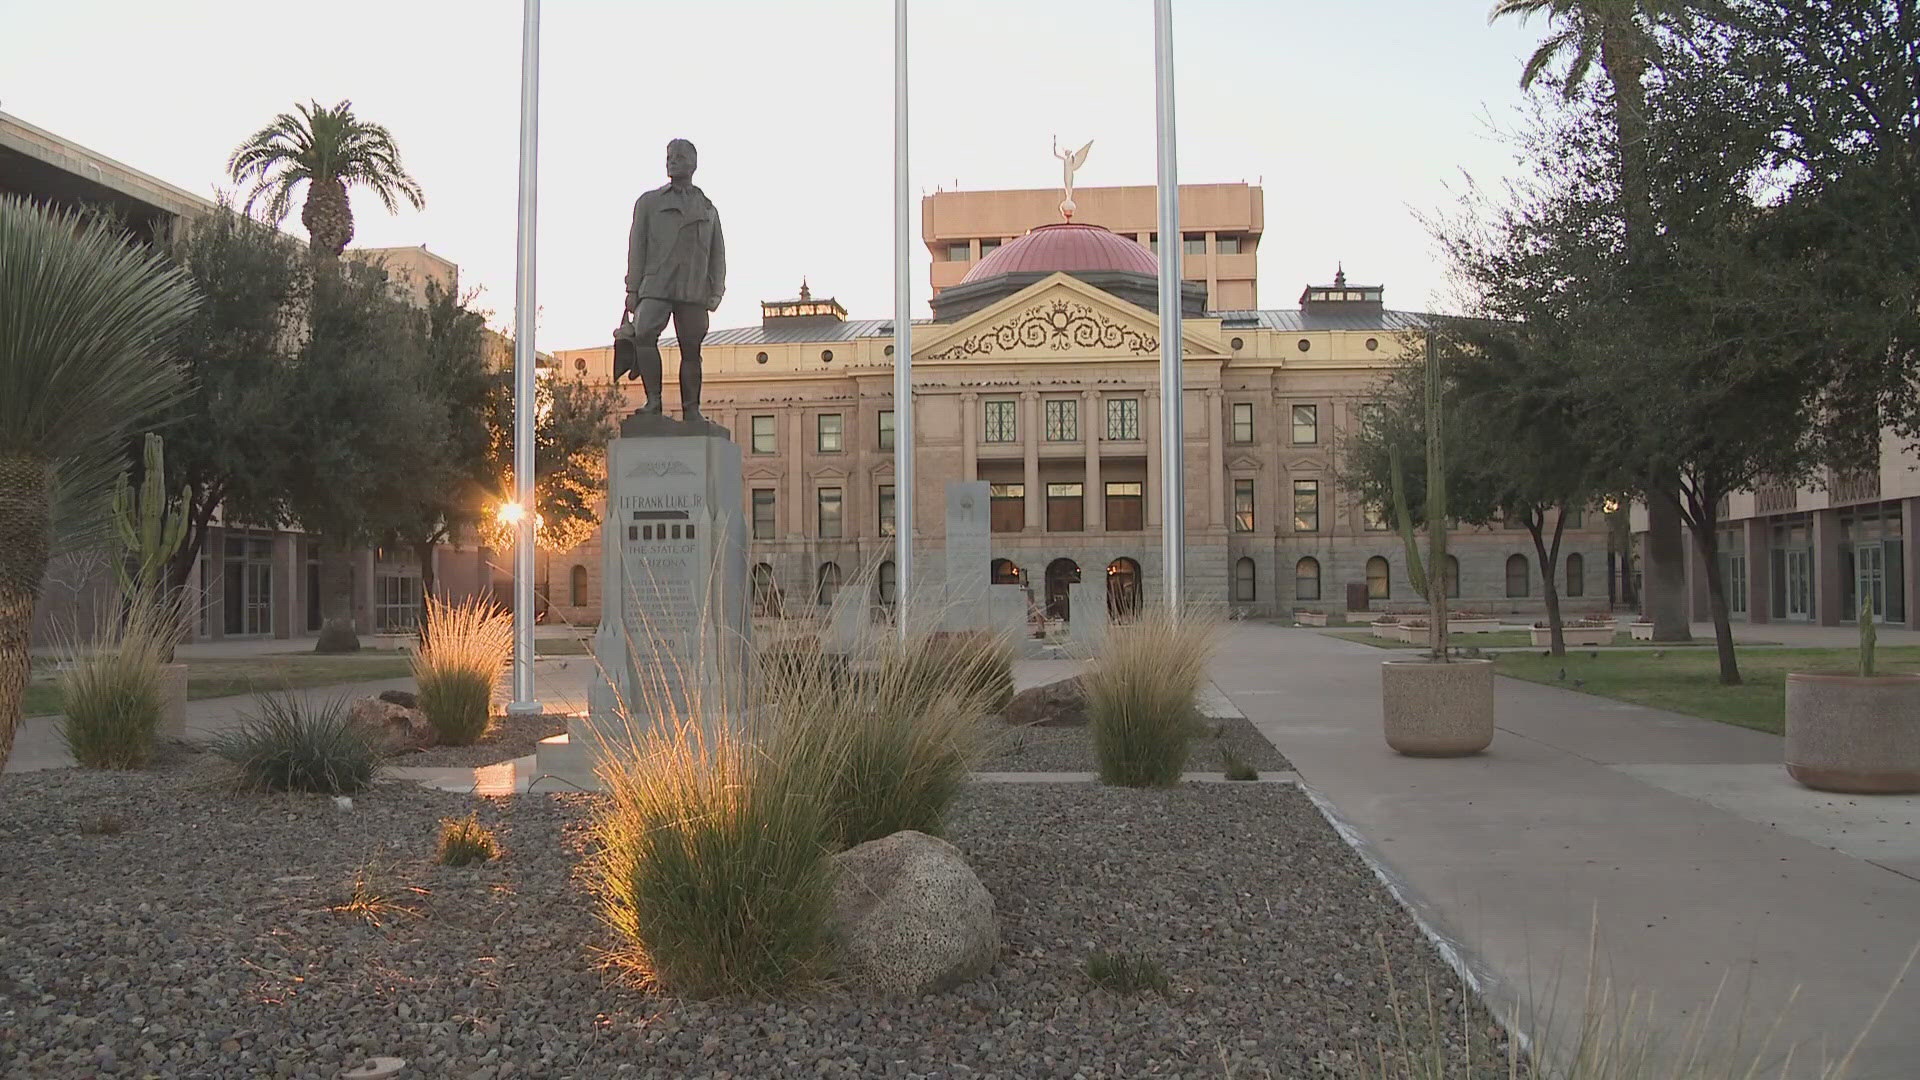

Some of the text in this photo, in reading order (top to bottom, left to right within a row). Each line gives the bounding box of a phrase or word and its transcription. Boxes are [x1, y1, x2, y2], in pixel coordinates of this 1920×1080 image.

[633, 495, 663, 508] FRANK
[666, 494, 687, 508] LUKE
[629, 544, 696, 555] THE STATE OF
[639, 559, 686, 568] ARIZONA
